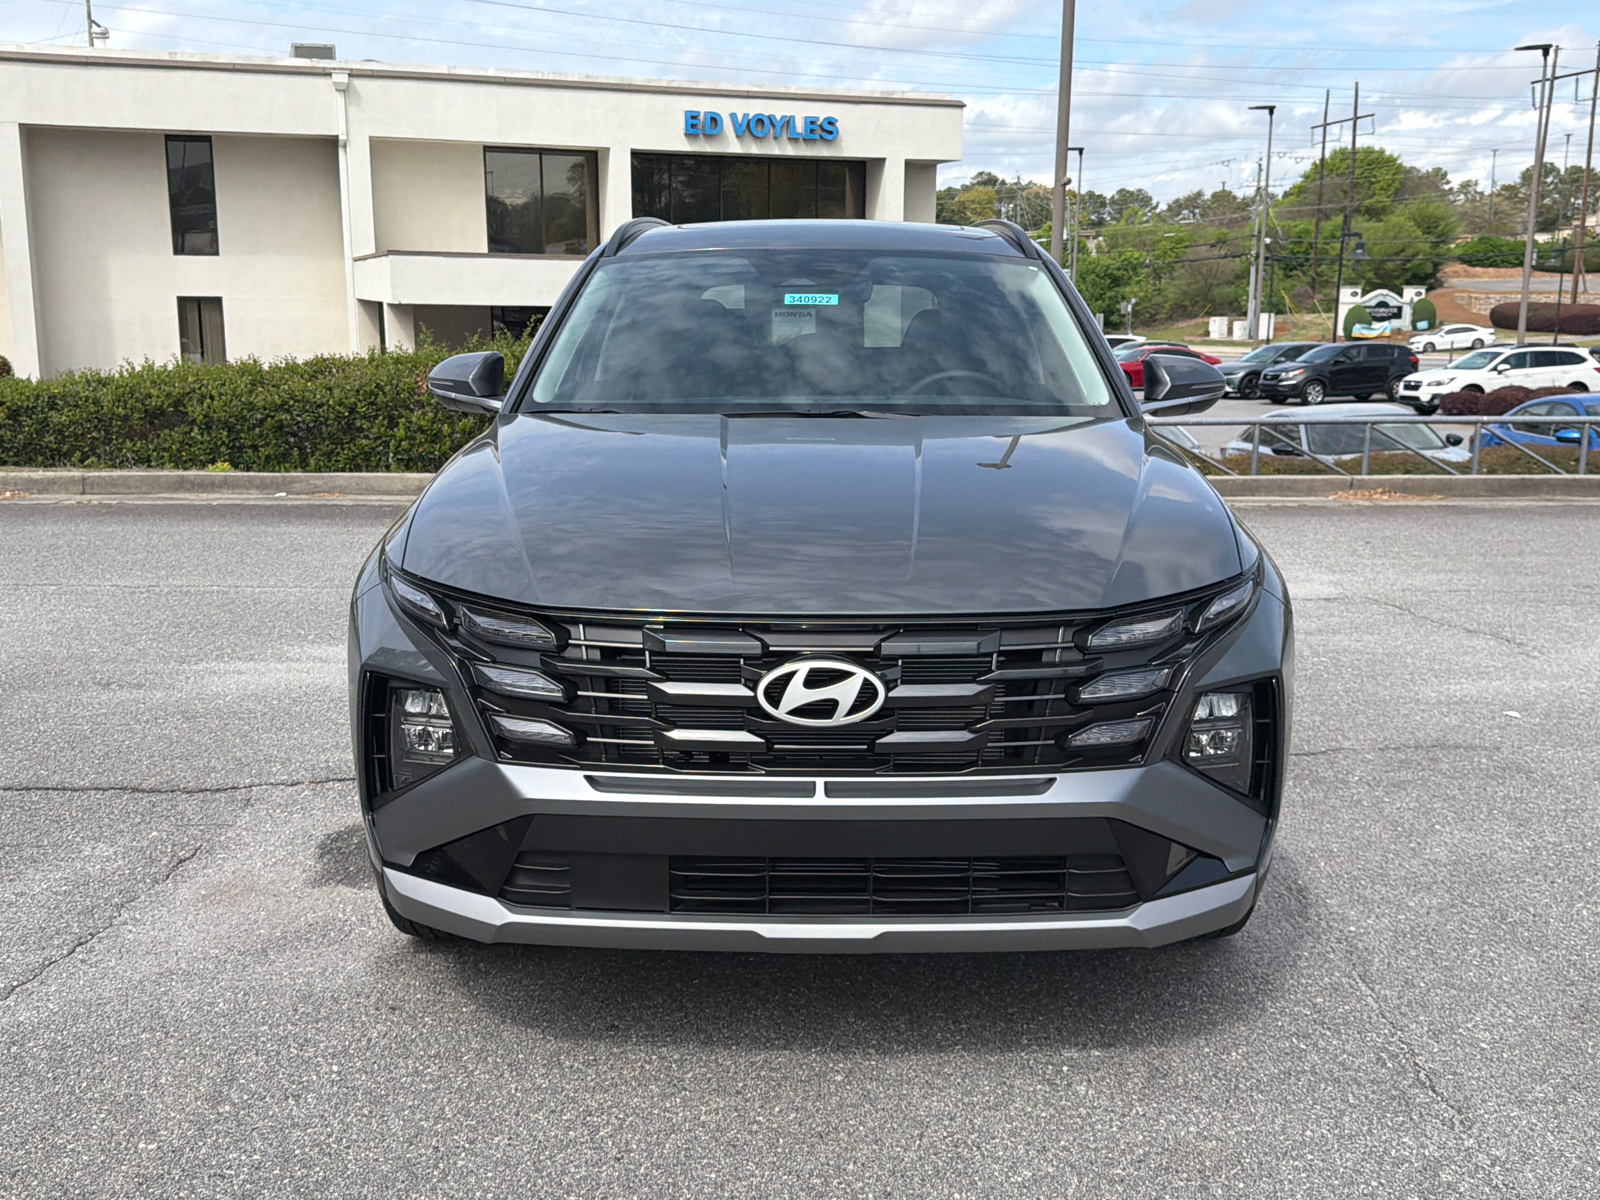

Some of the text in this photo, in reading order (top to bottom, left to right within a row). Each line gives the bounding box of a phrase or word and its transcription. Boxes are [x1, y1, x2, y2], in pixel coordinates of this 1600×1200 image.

[684, 110, 840, 141] ED VOYLES
[788, 295, 832, 304] 340922
